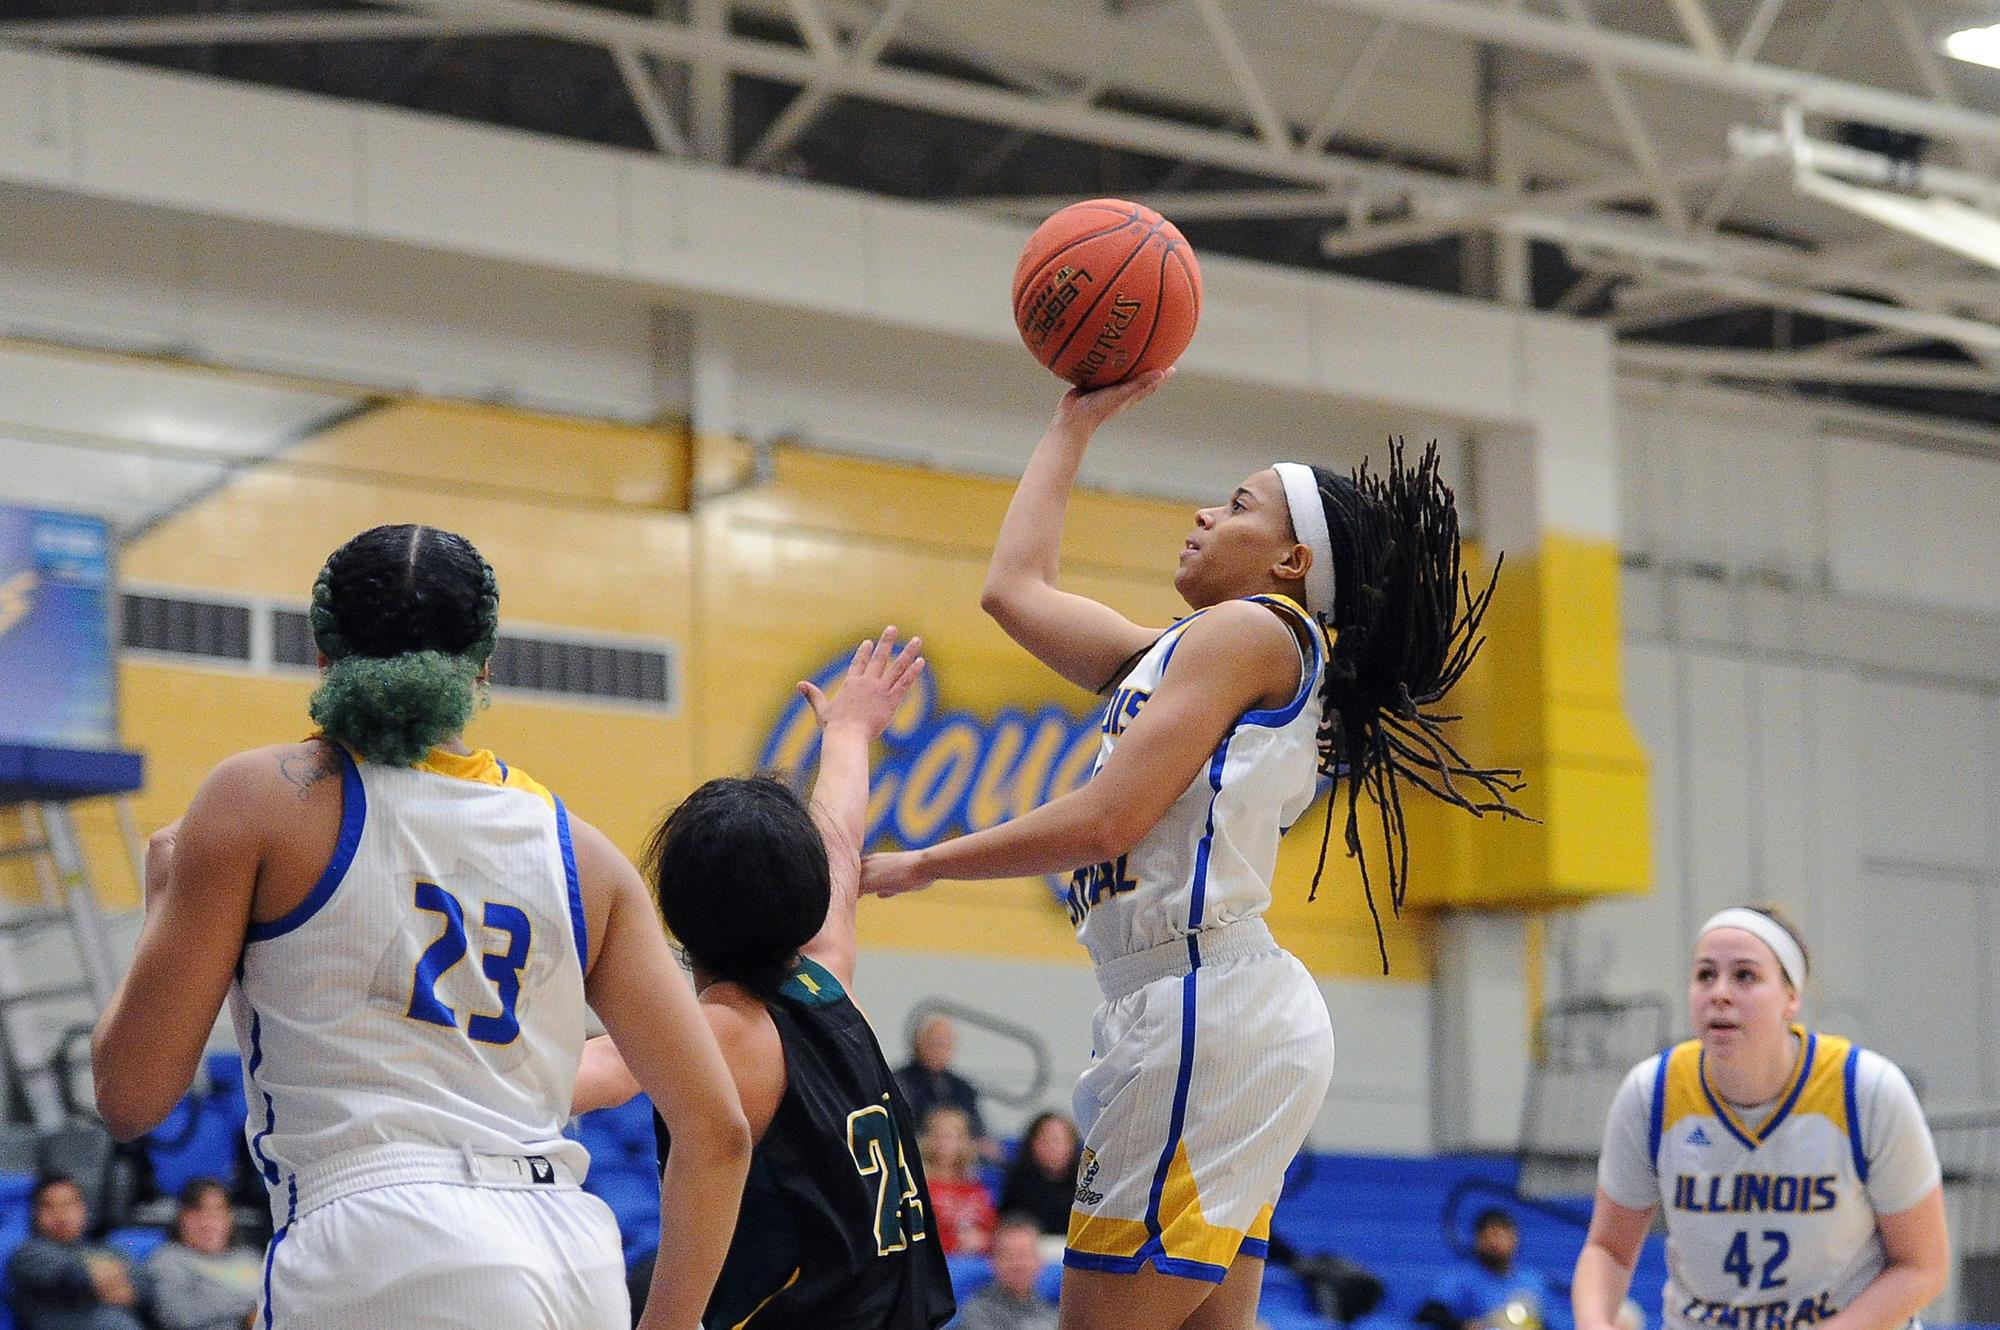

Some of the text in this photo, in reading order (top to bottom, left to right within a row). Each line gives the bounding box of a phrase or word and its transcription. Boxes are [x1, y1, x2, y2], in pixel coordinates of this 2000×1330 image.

[406, 880, 532, 1046] 23
[1674, 1173, 1838, 1215] ILLINOIS
[1723, 1230, 1791, 1290] 42
